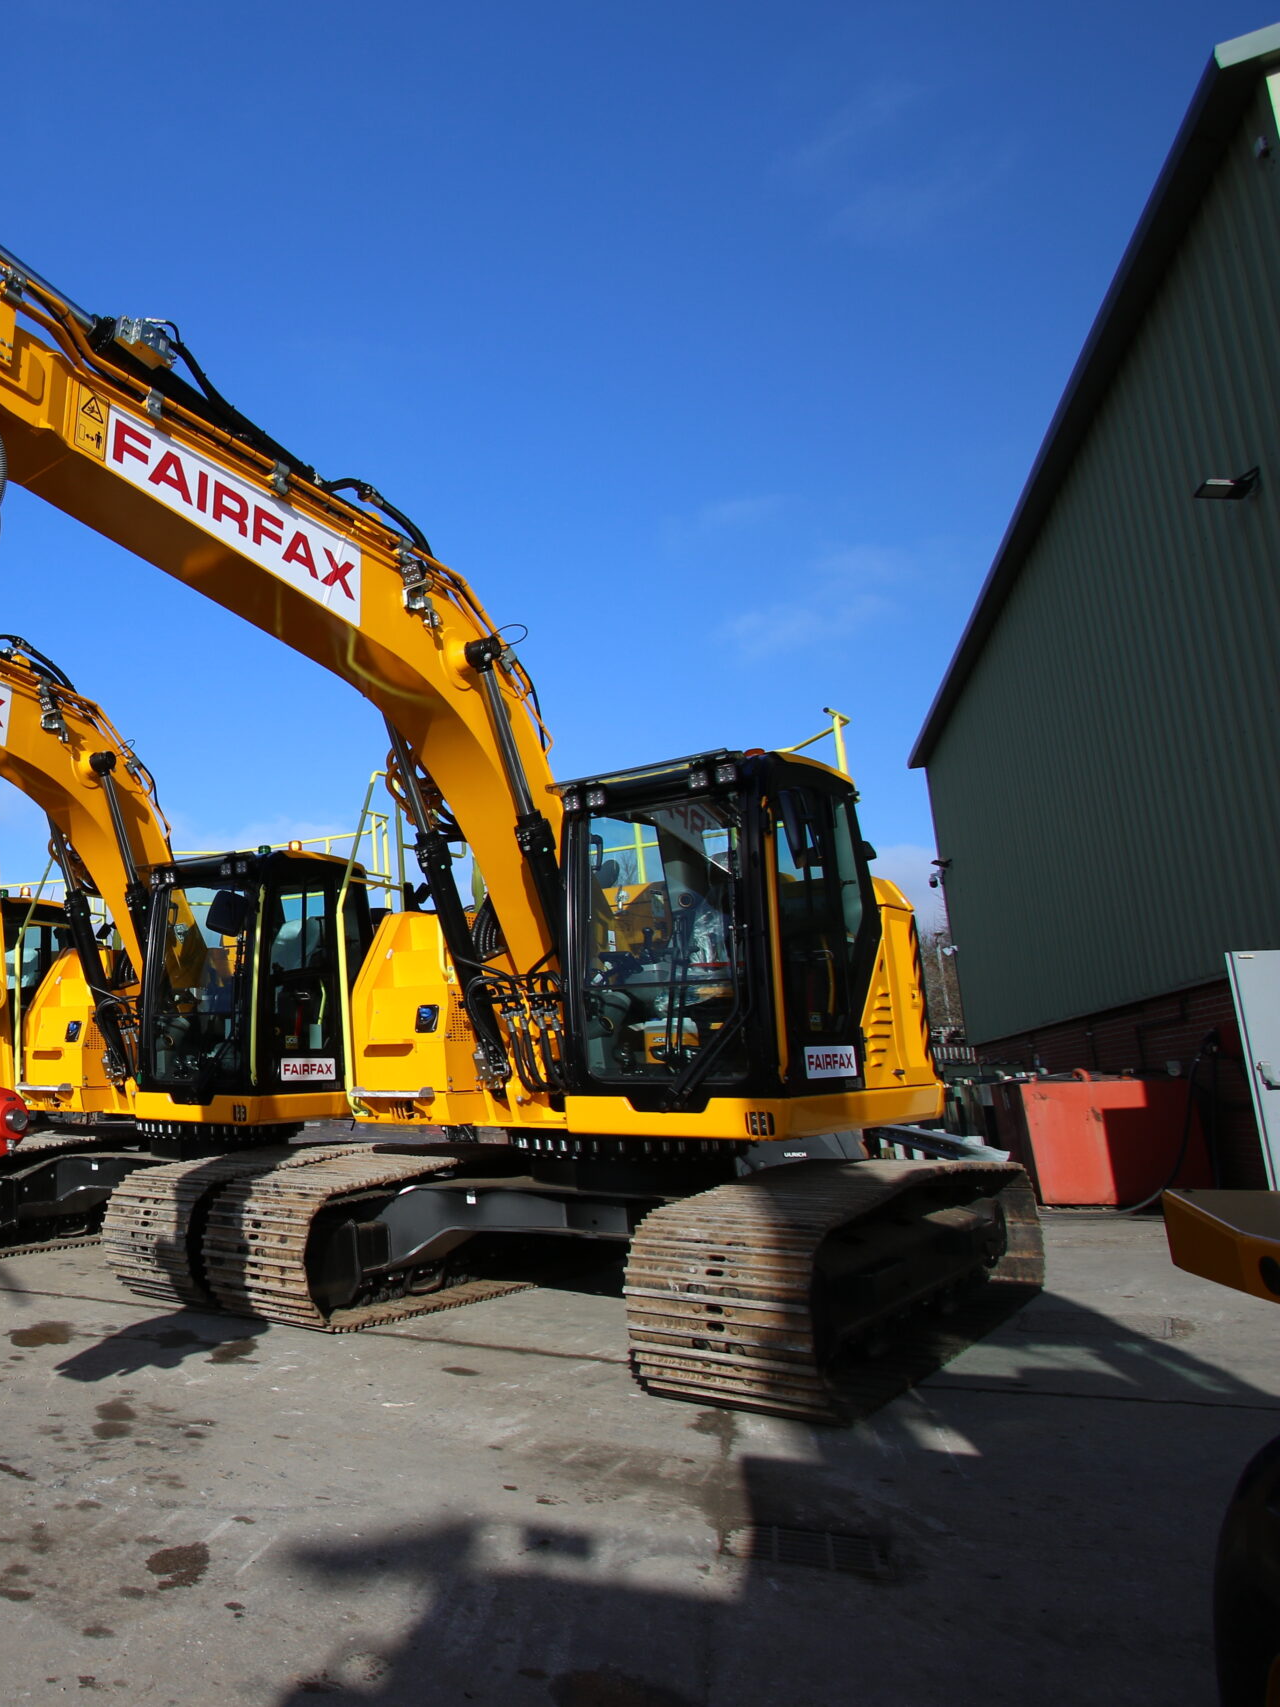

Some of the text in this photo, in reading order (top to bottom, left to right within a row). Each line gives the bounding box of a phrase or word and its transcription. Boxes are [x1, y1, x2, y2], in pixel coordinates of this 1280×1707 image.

[112, 419, 355, 601] FAIRFAX
[283, 1063, 333, 1076] FAIRFAX
[807, 1053, 854, 1071] FAIRFAX
